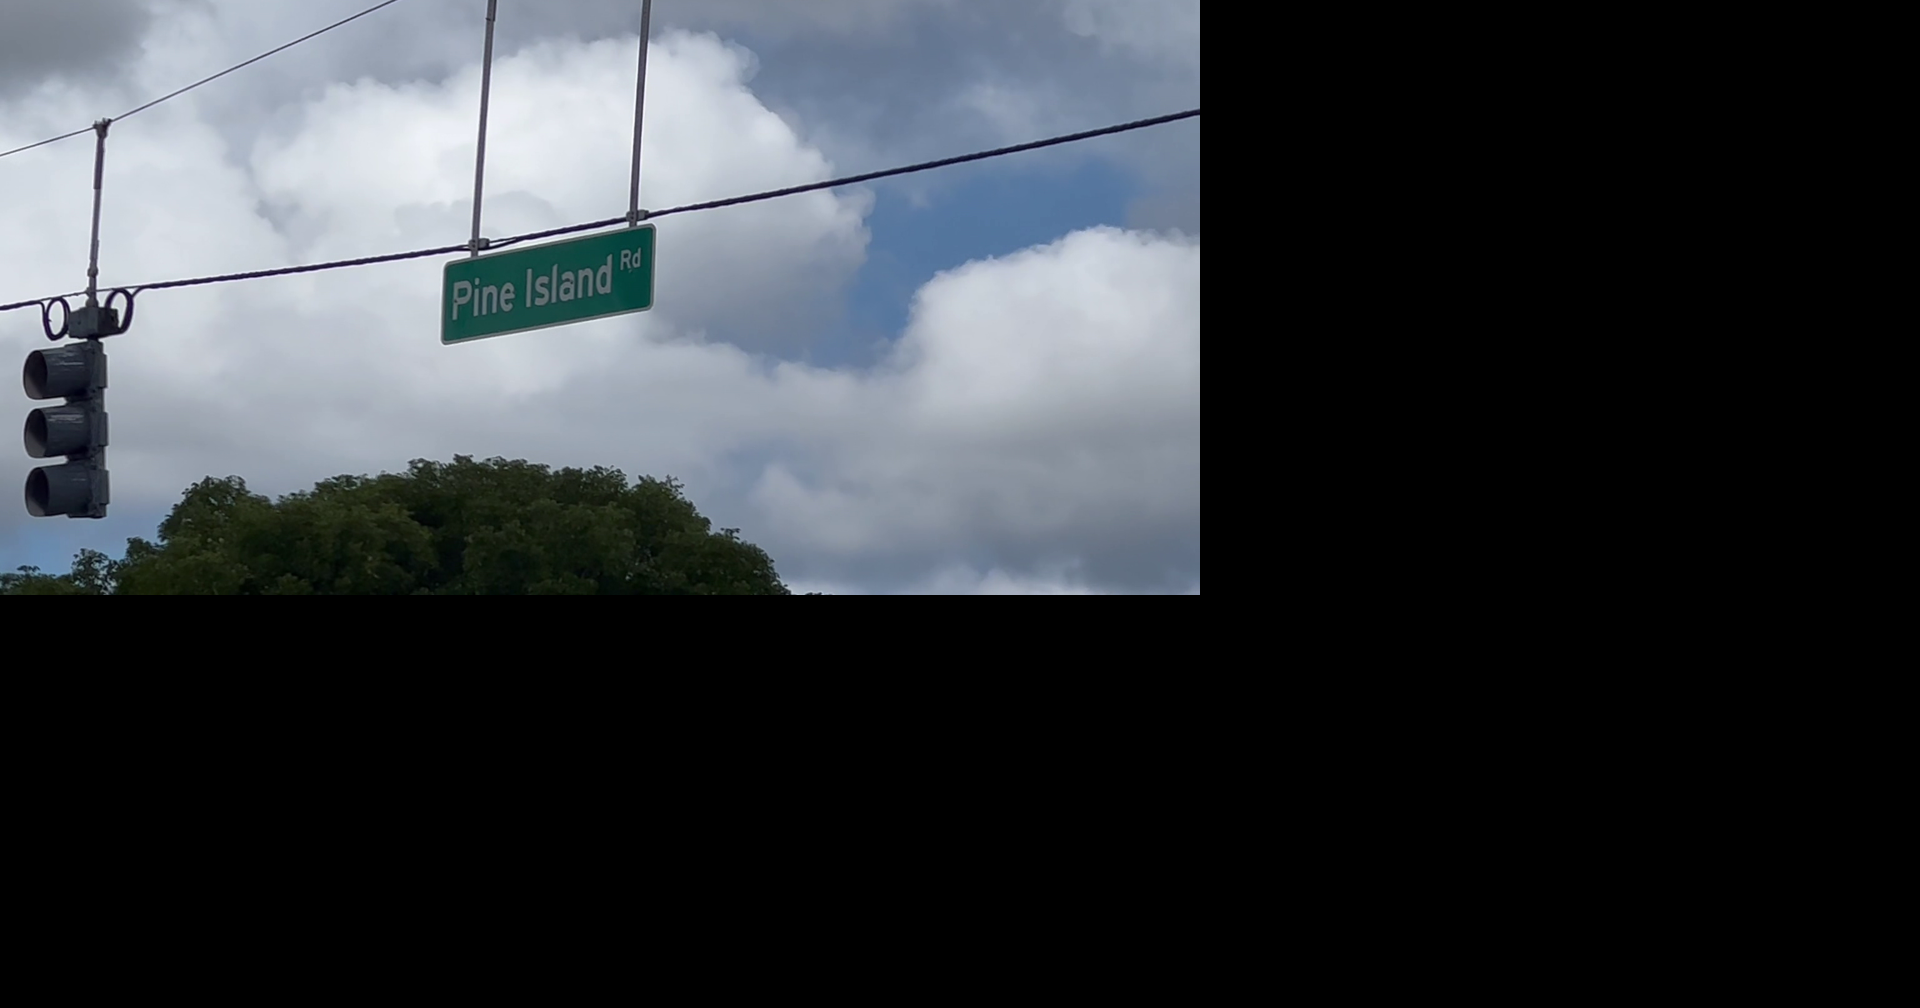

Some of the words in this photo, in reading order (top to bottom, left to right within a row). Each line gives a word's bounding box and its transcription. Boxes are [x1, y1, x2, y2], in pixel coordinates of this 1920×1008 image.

[452, 277, 515, 320] Pine
[525, 253, 613, 308] Island
[620, 247, 642, 271] Rd
